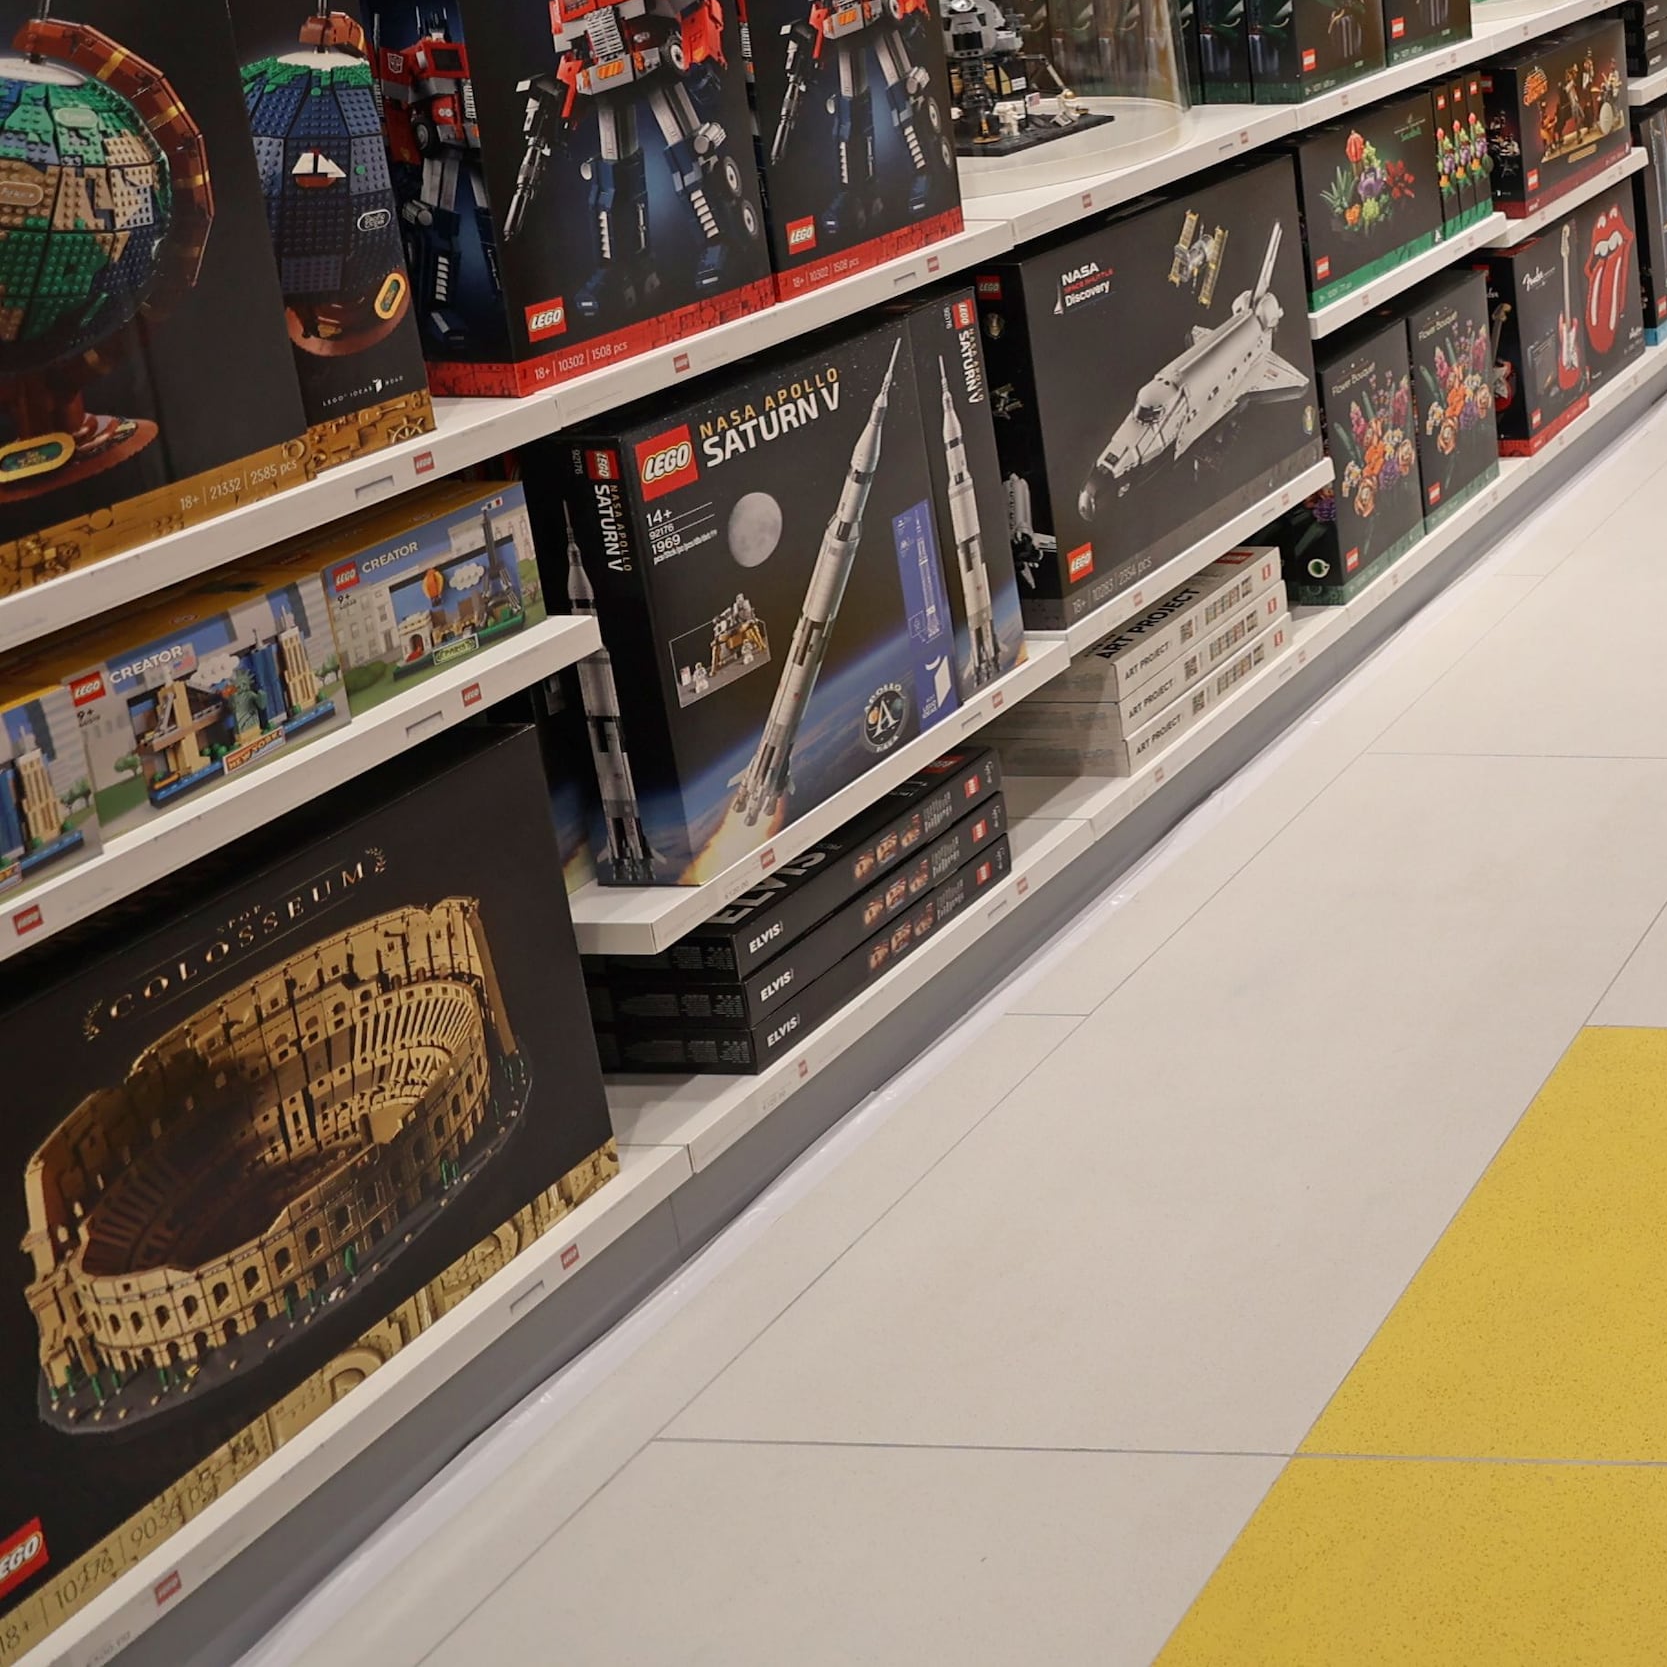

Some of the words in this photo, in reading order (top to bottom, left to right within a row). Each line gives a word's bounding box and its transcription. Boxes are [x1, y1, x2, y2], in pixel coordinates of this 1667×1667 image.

[791, 275, 805, 288] 18+
[1061, 262, 1100, 285] NASA
[1064, 279, 1112, 308] Discovery
[528, 309, 562, 331] LEGO
[534, 365, 551, 381] 18+
[558, 353, 586, 373] 10302
[591, 345, 611, 361] 1508
[612, 340, 628, 357] pcs
[699, 404, 756, 439] NASA
[763, 367, 839, 409] APOLLO
[702, 398, 820, 468] SATURN
[820, 381, 840, 412] V
[642, 442, 691, 483] LEGO
[179, 494, 200, 511] 18+
[209, 477, 242, 500] 21332
[249, 464, 278, 486] 2585
[594, 484, 621, 557] SATURN
[645, 508, 673, 527] 14+
[362, 540, 419, 575] CREATOR
[651, 534, 682, 556] 1969
[1095, 636, 1134, 661] ART
[1130, 587, 1201, 635] PROJECT
[109, 644, 185, 685] CREATOR
[1124, 666, 1140, 681] ART
[1139, 642, 1170, 671] PROJECT
[76, 706, 95, 720] 9+
[1128, 704, 1143, 720] ART
[1143, 678, 1174, 708] PROJECT
[1135, 741, 1151, 756] ART
[1150, 713, 1182, 746] PROJECT
[109, 861, 363, 1020] COLOSSEUM
[749, 922, 781, 954] ELVIS
[760, 969, 792, 1002] ELVIS
[767, 1016, 799, 1048] ELVIS
